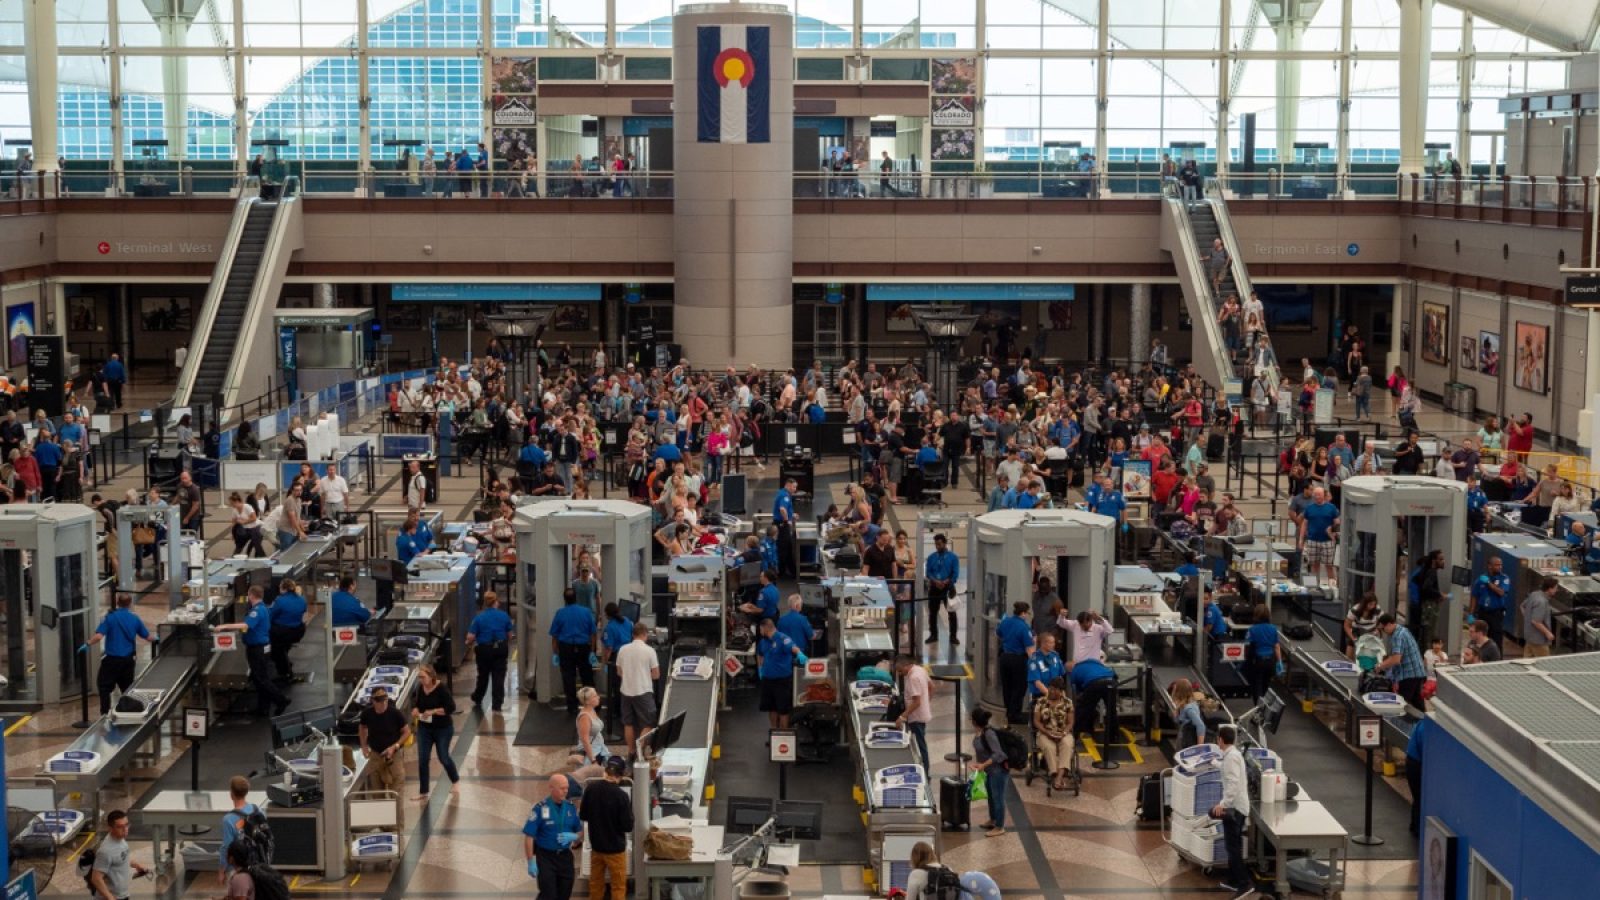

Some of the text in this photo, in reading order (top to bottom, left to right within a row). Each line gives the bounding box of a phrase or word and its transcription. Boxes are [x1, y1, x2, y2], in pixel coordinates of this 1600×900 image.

[116, 242, 213, 253] Terminal West
[1255, 243, 1342, 254] Terminal East
[1571, 285, 1597, 293] Ground
[156, 511, 164, 521] 2
